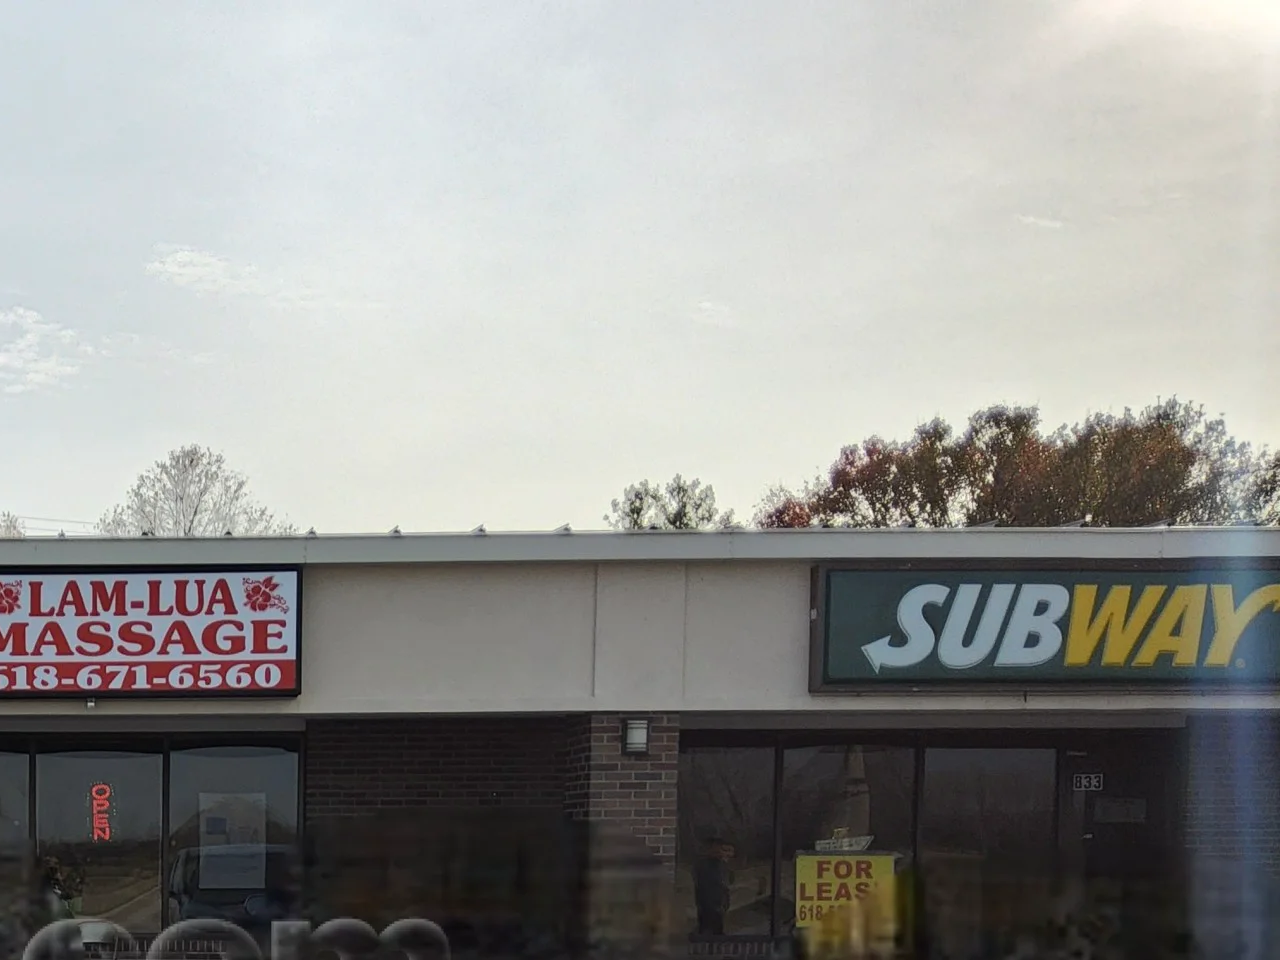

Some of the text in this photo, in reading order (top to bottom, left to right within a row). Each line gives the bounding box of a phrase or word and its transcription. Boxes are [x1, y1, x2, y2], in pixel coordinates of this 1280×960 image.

[28, 578, 239, 617] LAM-LUA
[861, 583, 1280, 675] SUBWAY
[1075, 775, 1101, 789] 833
[91, 783, 112, 841] OPEN
[817, 860, 874, 879] FOR
[800, 882, 877, 902] LEAS
